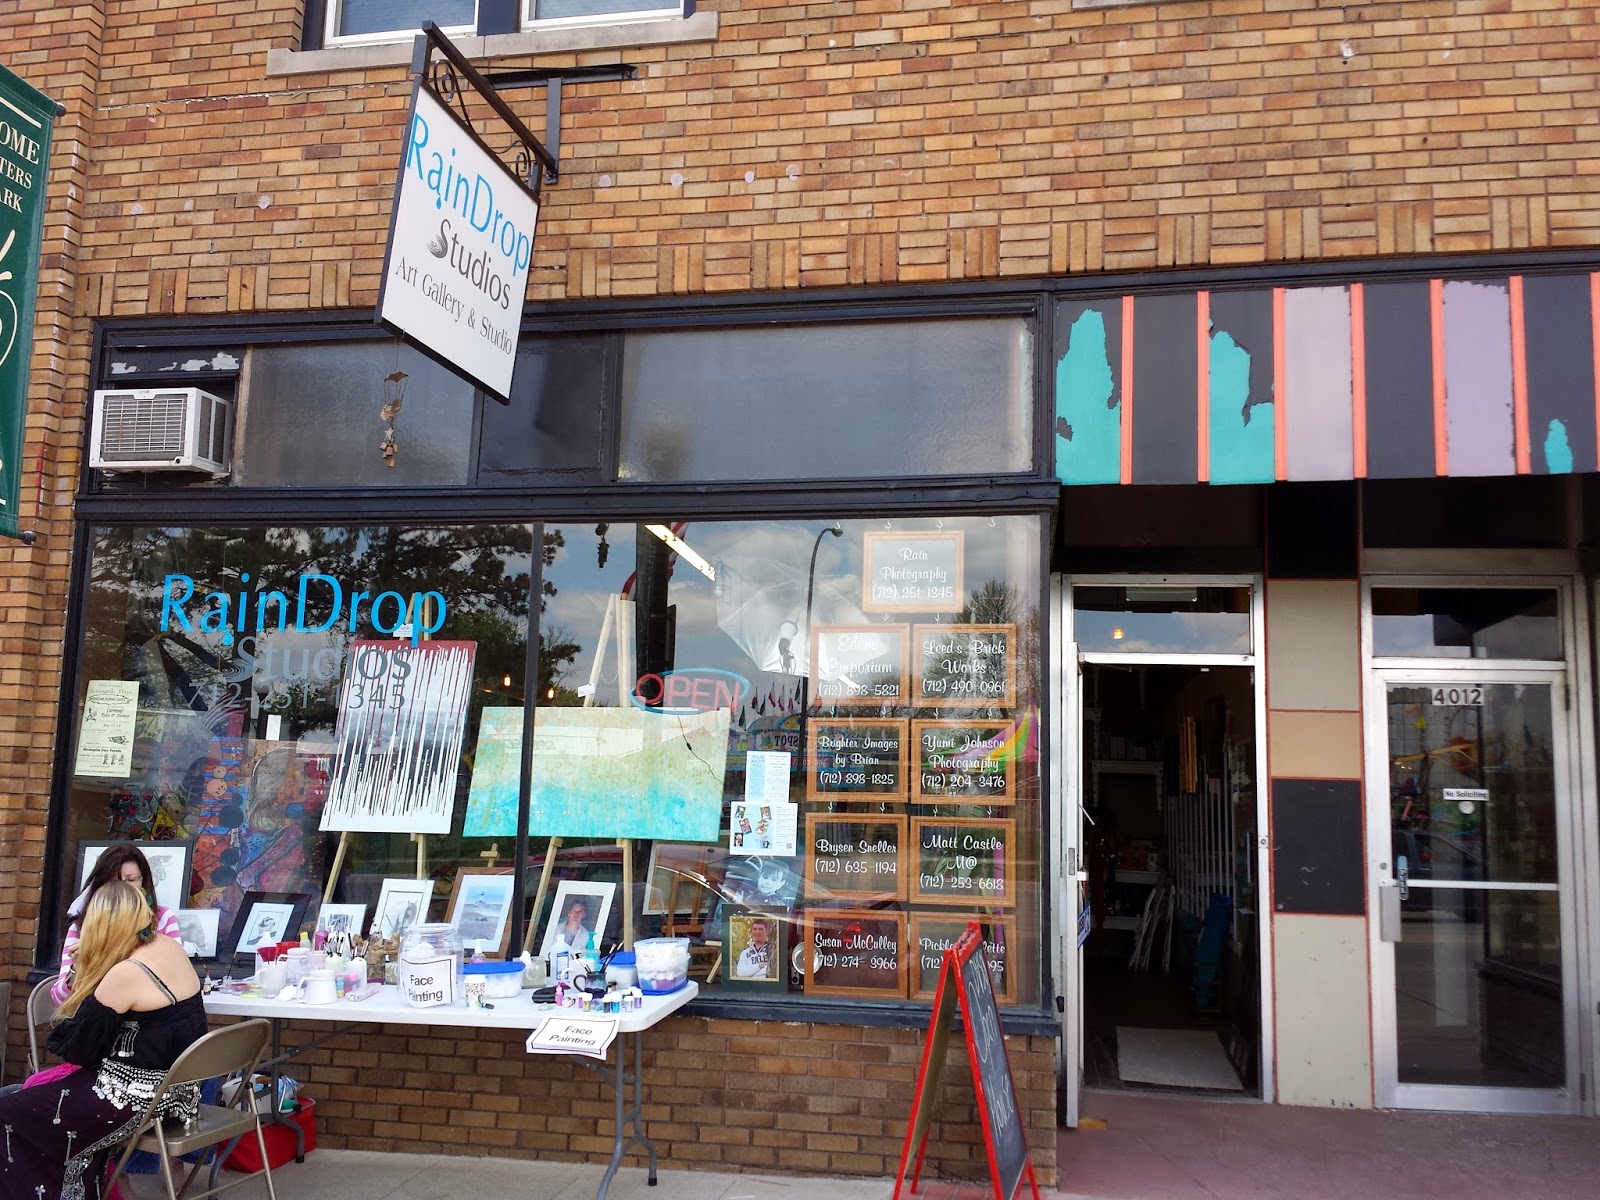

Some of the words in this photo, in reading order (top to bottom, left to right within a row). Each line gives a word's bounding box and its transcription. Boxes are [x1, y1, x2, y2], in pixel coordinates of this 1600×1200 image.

[0, 187, 23, 213] RK
[407, 112, 530, 278] RainDrop
[426, 218, 511, 310] Studios
[396, 257, 418, 287] Art
[422, 274, 465, 322] Gallery
[467, 308, 476, 330] &
[480, 316, 512, 355] Studio
[899, 547, 928, 561] Rain
[880, 566, 947, 582] Photography
[872, 584, 897, 600] (712)
[902, 586, 953, 599] 251-1345
[160, 572, 448, 648] RainDrop
[968, 640, 1006, 655] Brick
[221, 636, 412, 683] Studios
[828, 656, 893, 678] Emporium
[941, 659, 987, 674] Works
[636, 673, 741, 713] OPEN
[818, 682, 842, 698] (712)
[846, 684, 899, 696] 898-5821
[922, 678, 947, 694] (712)
[187, 682, 406, 711] 712-251-1345
[1434, 688, 1481, 704] 4012
[817, 735, 858, 750] Brighter
[861, 736, 898, 752] Images
[922, 734, 955, 752] Yumi
[960, 734, 1005, 752] Johnson
[835, 753, 846, 768] by
[850, 752, 880, 766] Brian
[928, 754, 999, 773] Photography
[820, 770, 842, 785] (712)
[845, 773, 894, 785] 898-1825
[921, 772, 946, 789] (712)
[950, 774, 1006, 788] 204-3476
[815, 838, 854, 857] Brysen
[858, 840, 897, 854] Sneller
[922, 834, 958, 849] Matt
[963, 834, 1002, 851] Castle
[815, 857, 841, 875] (712)
[845, 860, 897, 875] 635-1194
[814, 932, 842, 948] Susan
[845, 934, 897, 955] McCulley
[814, 952, 838, 969] (712)
[410, 974, 434, 986] Face
[564, 1024, 593, 1036] Face
[549, 1034, 596, 1046] Painting
